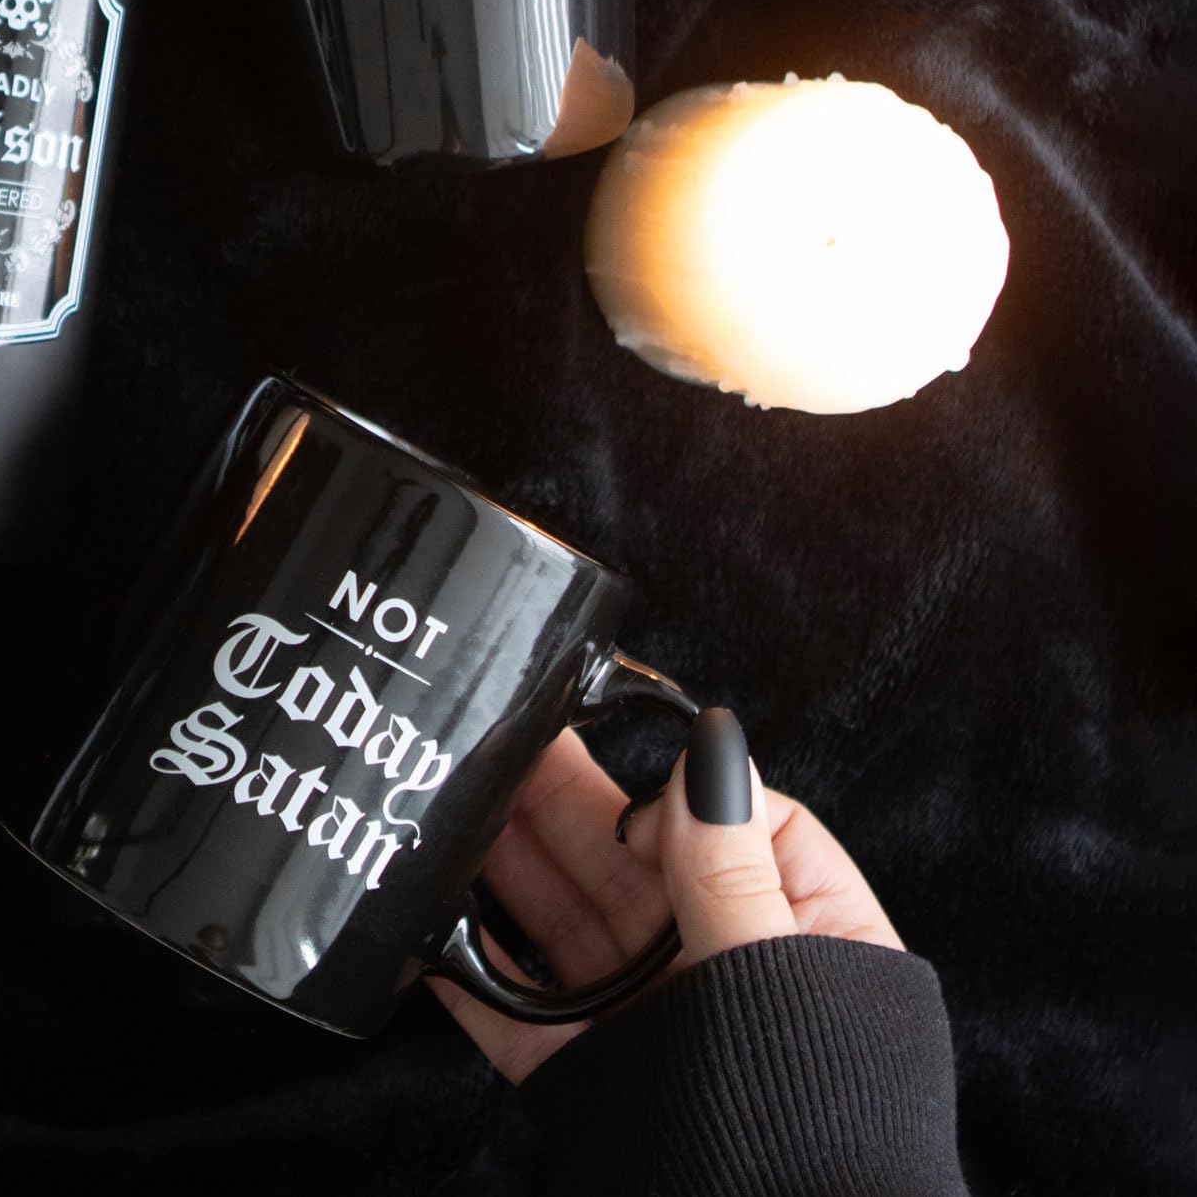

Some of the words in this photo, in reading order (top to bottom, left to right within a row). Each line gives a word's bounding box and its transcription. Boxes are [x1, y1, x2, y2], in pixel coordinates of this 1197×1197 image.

[328, 570, 449, 659] NOT
[149, 701, 403, 890] Satan
[213, 613, 452, 850] Today
